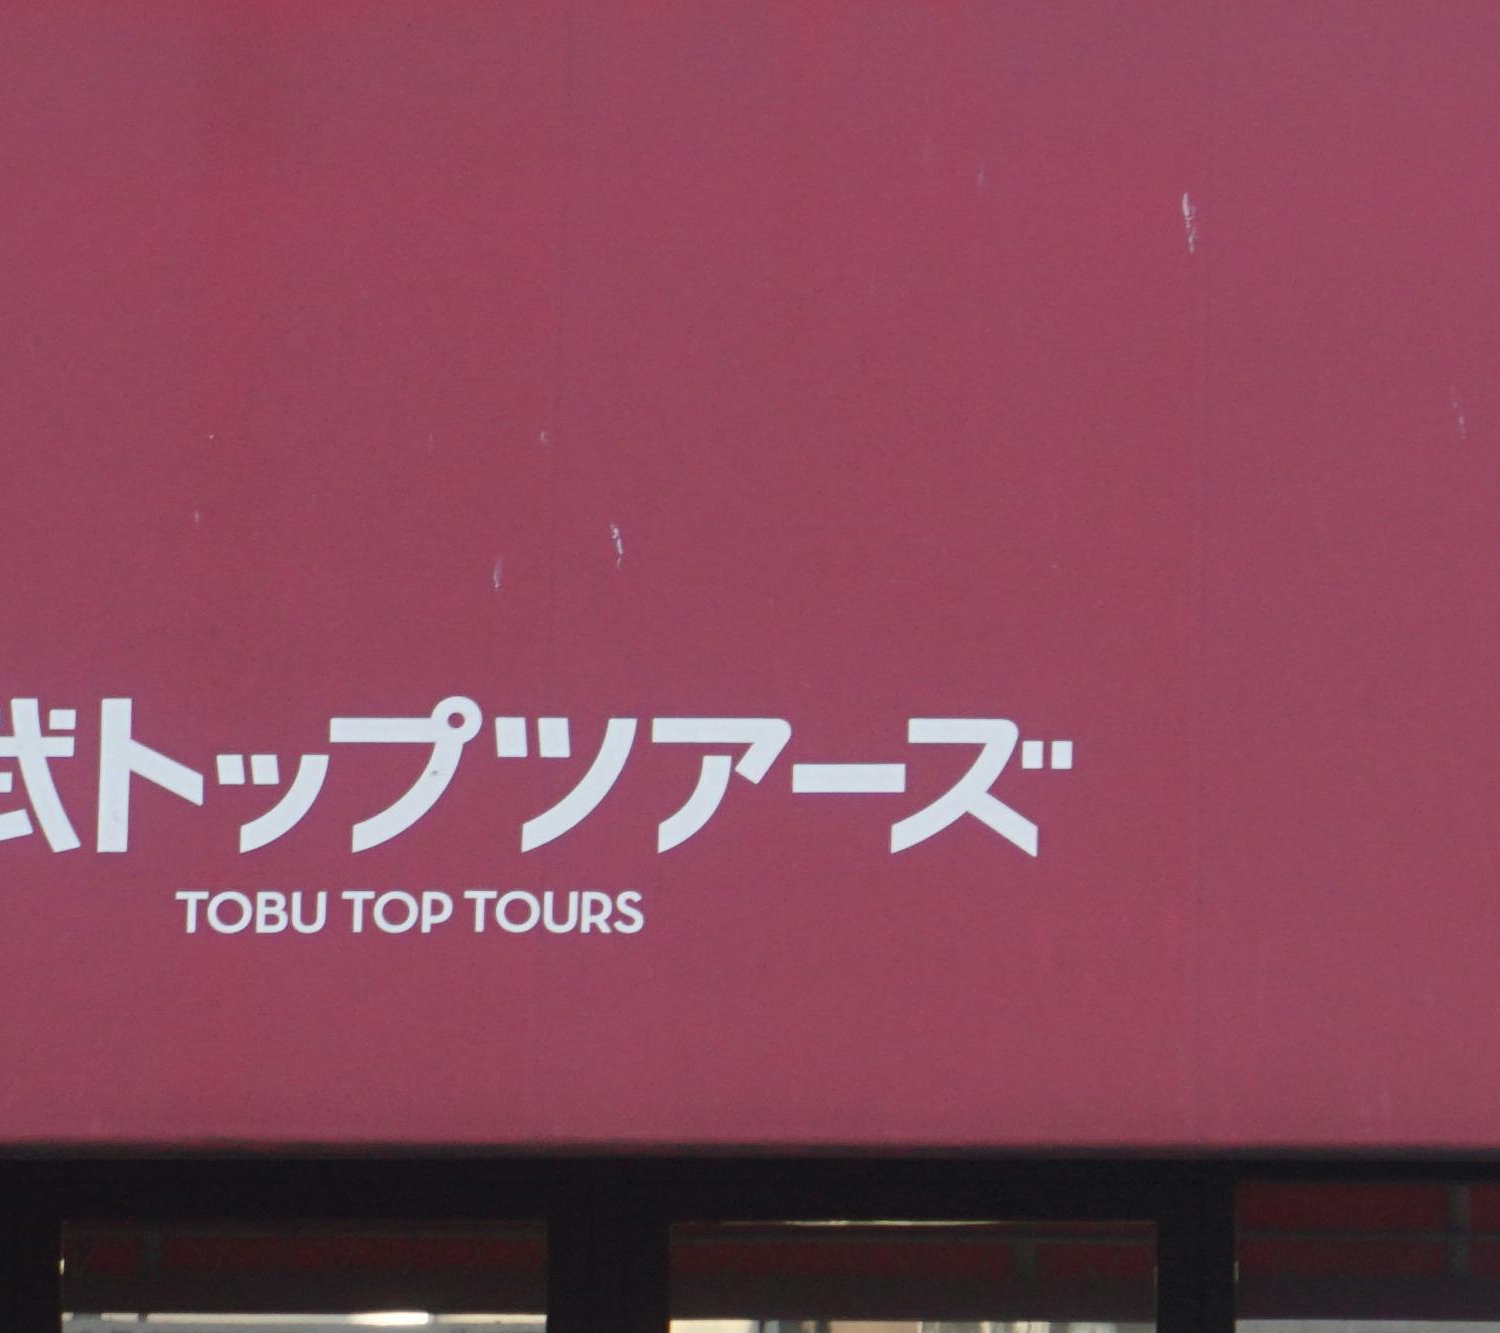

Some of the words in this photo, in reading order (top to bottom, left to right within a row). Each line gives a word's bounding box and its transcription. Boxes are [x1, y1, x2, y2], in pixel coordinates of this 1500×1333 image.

[174, 889, 328, 935] TOBU
[340, 889, 454, 935] TOP
[463, 889, 645, 935] TOURS
